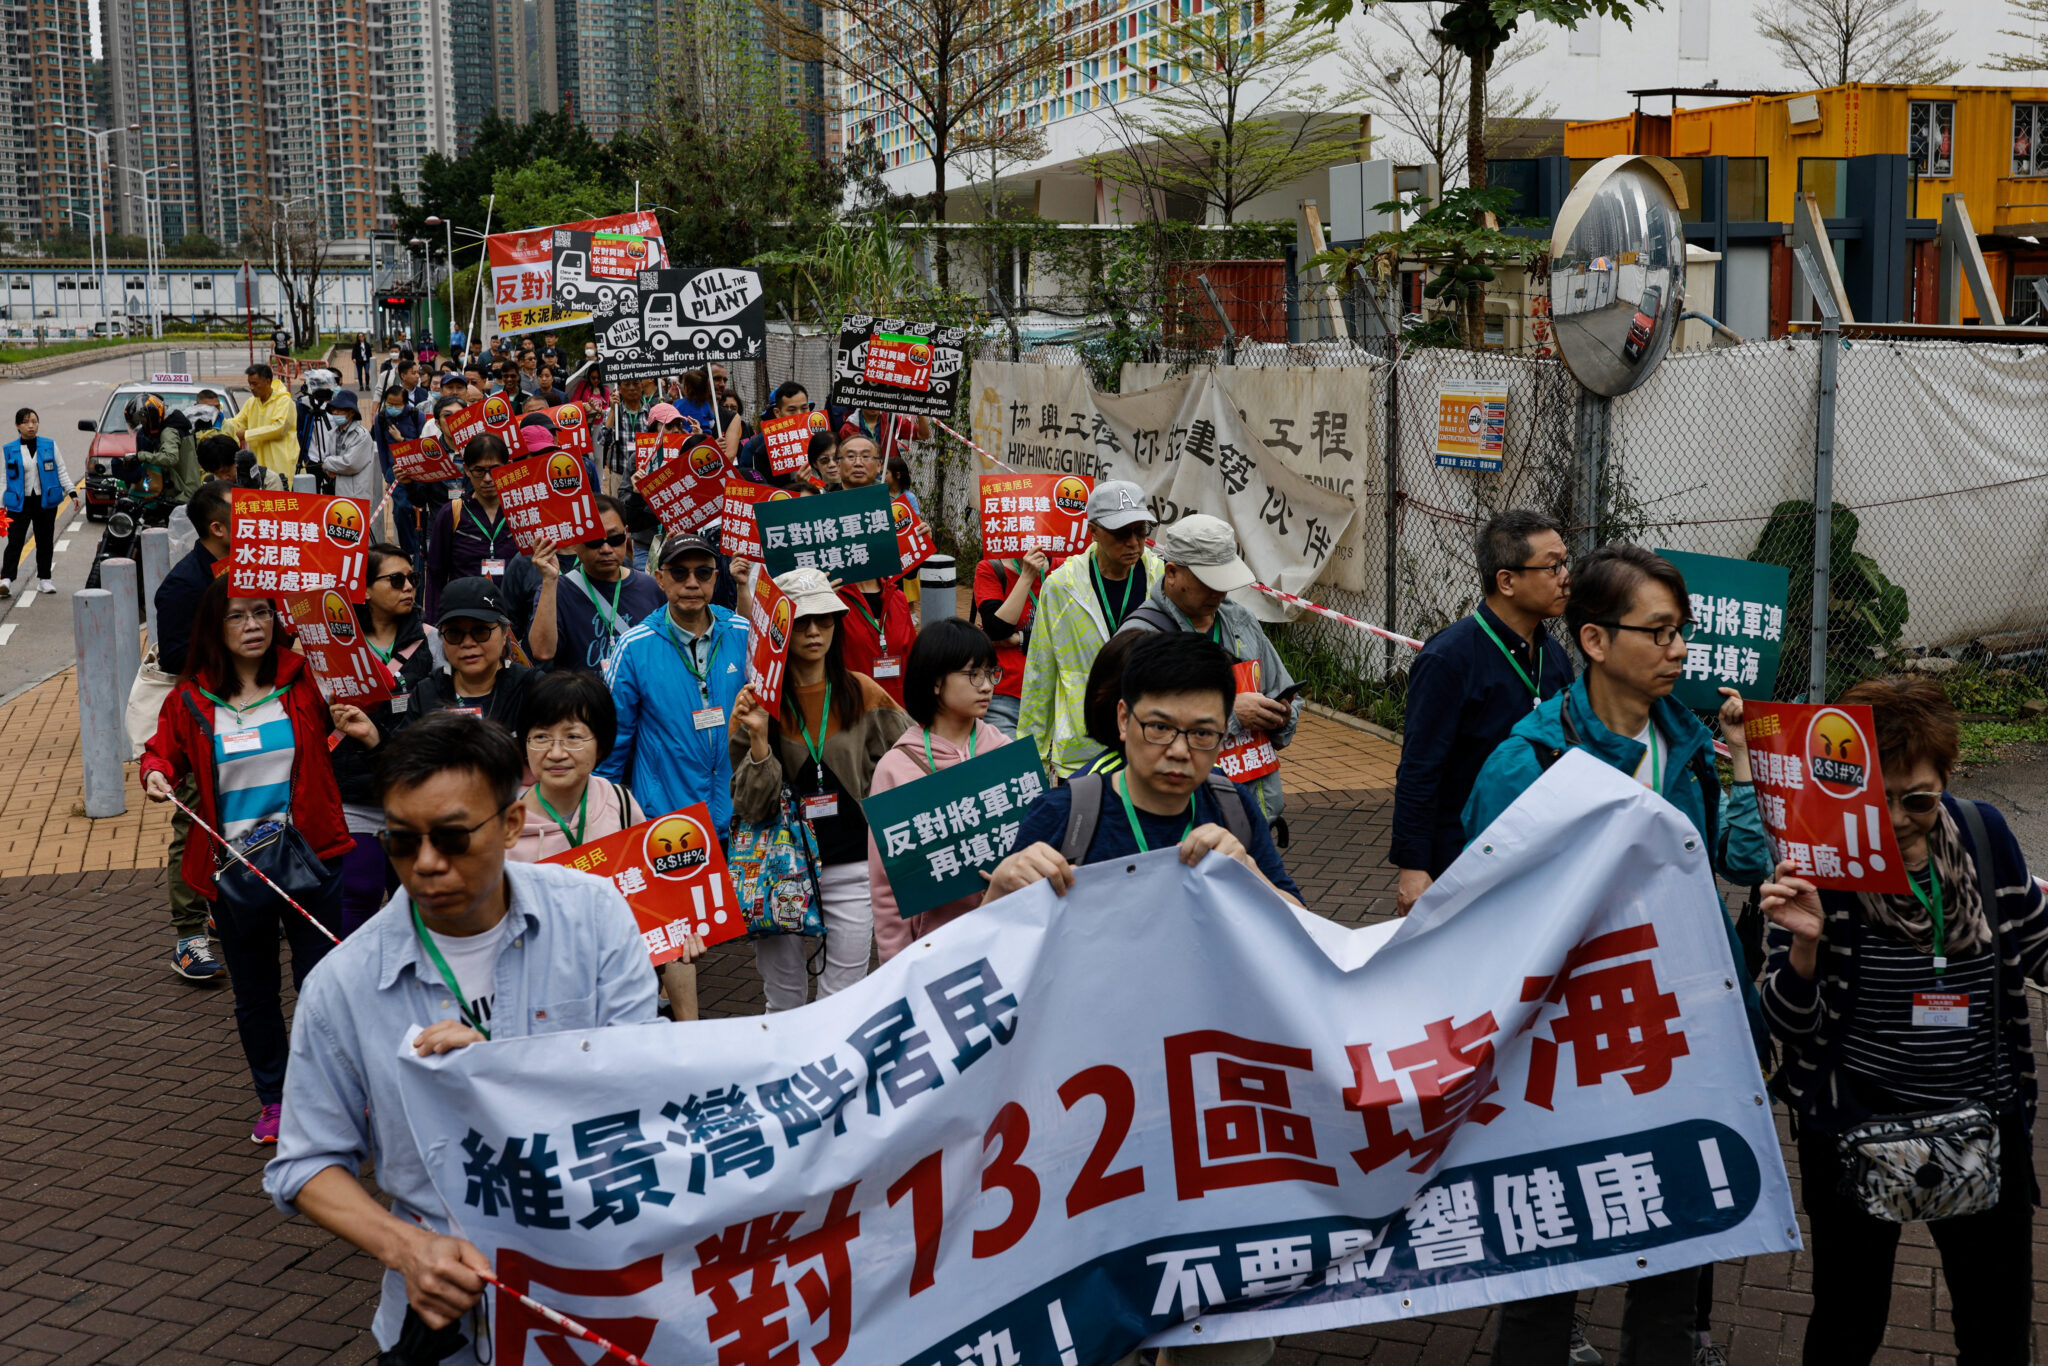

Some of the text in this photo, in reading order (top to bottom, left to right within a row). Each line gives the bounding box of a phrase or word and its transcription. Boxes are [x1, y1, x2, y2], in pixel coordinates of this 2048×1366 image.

[691, 273, 748, 298] KILL THE
[691, 288, 749, 319] PLANT
[613, 320, 633, 334] KILL
[613, 330, 639, 345] PLAN
[663, 350, 741, 361] before it kills us!
[868, 358, 896, 371] 水泥廠
[932, 349, 950, 360] ILL
[619, 371, 633, 380] Govt
[635, 368, 660, 377] inaction
[670, 365, 687, 374] illegal
[931, 360, 959, 373] LANT
[155, 374, 189, 382] TAXI
[841, 386, 855, 394] END
[836, 396, 850, 404] END
[852, 397, 867, 407] Govt
[869, 399, 897, 410] inaction
[909, 404, 929, 415] illegal
[453, 420, 486, 446] 反對興建
[767, 427, 809, 446] 反對興建
[770, 442, 803, 459] 水泥廠
[1008, 442, 1026, 465] HIP
[1027, 444, 1052, 469] HING
[553, 477, 580, 488] &$!#%
[649, 474, 698, 510] 反對興建
[982, 479, 1032, 495] 將軍澳居民
[235, 498, 299, 514] 將軍澳居民
[501, 482, 549, 509] 反對興建
[985, 496, 1051, 514] 反對興建
[1058, 497, 1085, 511] &$!#%
[508, 507, 541, 530] 水泥廠
[660, 495, 696, 523] 水泥廠
[724, 499, 756, 520] 反對興
[236, 519, 319, 542] 反對興建
[328, 524, 359, 541] &$!#%
[723, 517, 751, 537] 水泥廠
[765, 509, 890, 549] 反對將軍澳
[985, 516, 1035, 533] 水泥廠
[235, 545, 301, 566] 水泥廠
[722, 533, 764, 558] 垃圾處理
[794, 543, 870, 571] 再填海
[1688, 593, 1783, 642] 對將軍澳
[1682, 642, 1760, 685] 再填海
[1750, 749, 1804, 790] 反對興建
[1813, 757, 1864, 789] &$!#%
[882, 771, 1044, 857] 反對將軍澳
[656, 849, 705, 871] &$!#%
[461, 957, 1018, 1230] 維景灣畔居民
